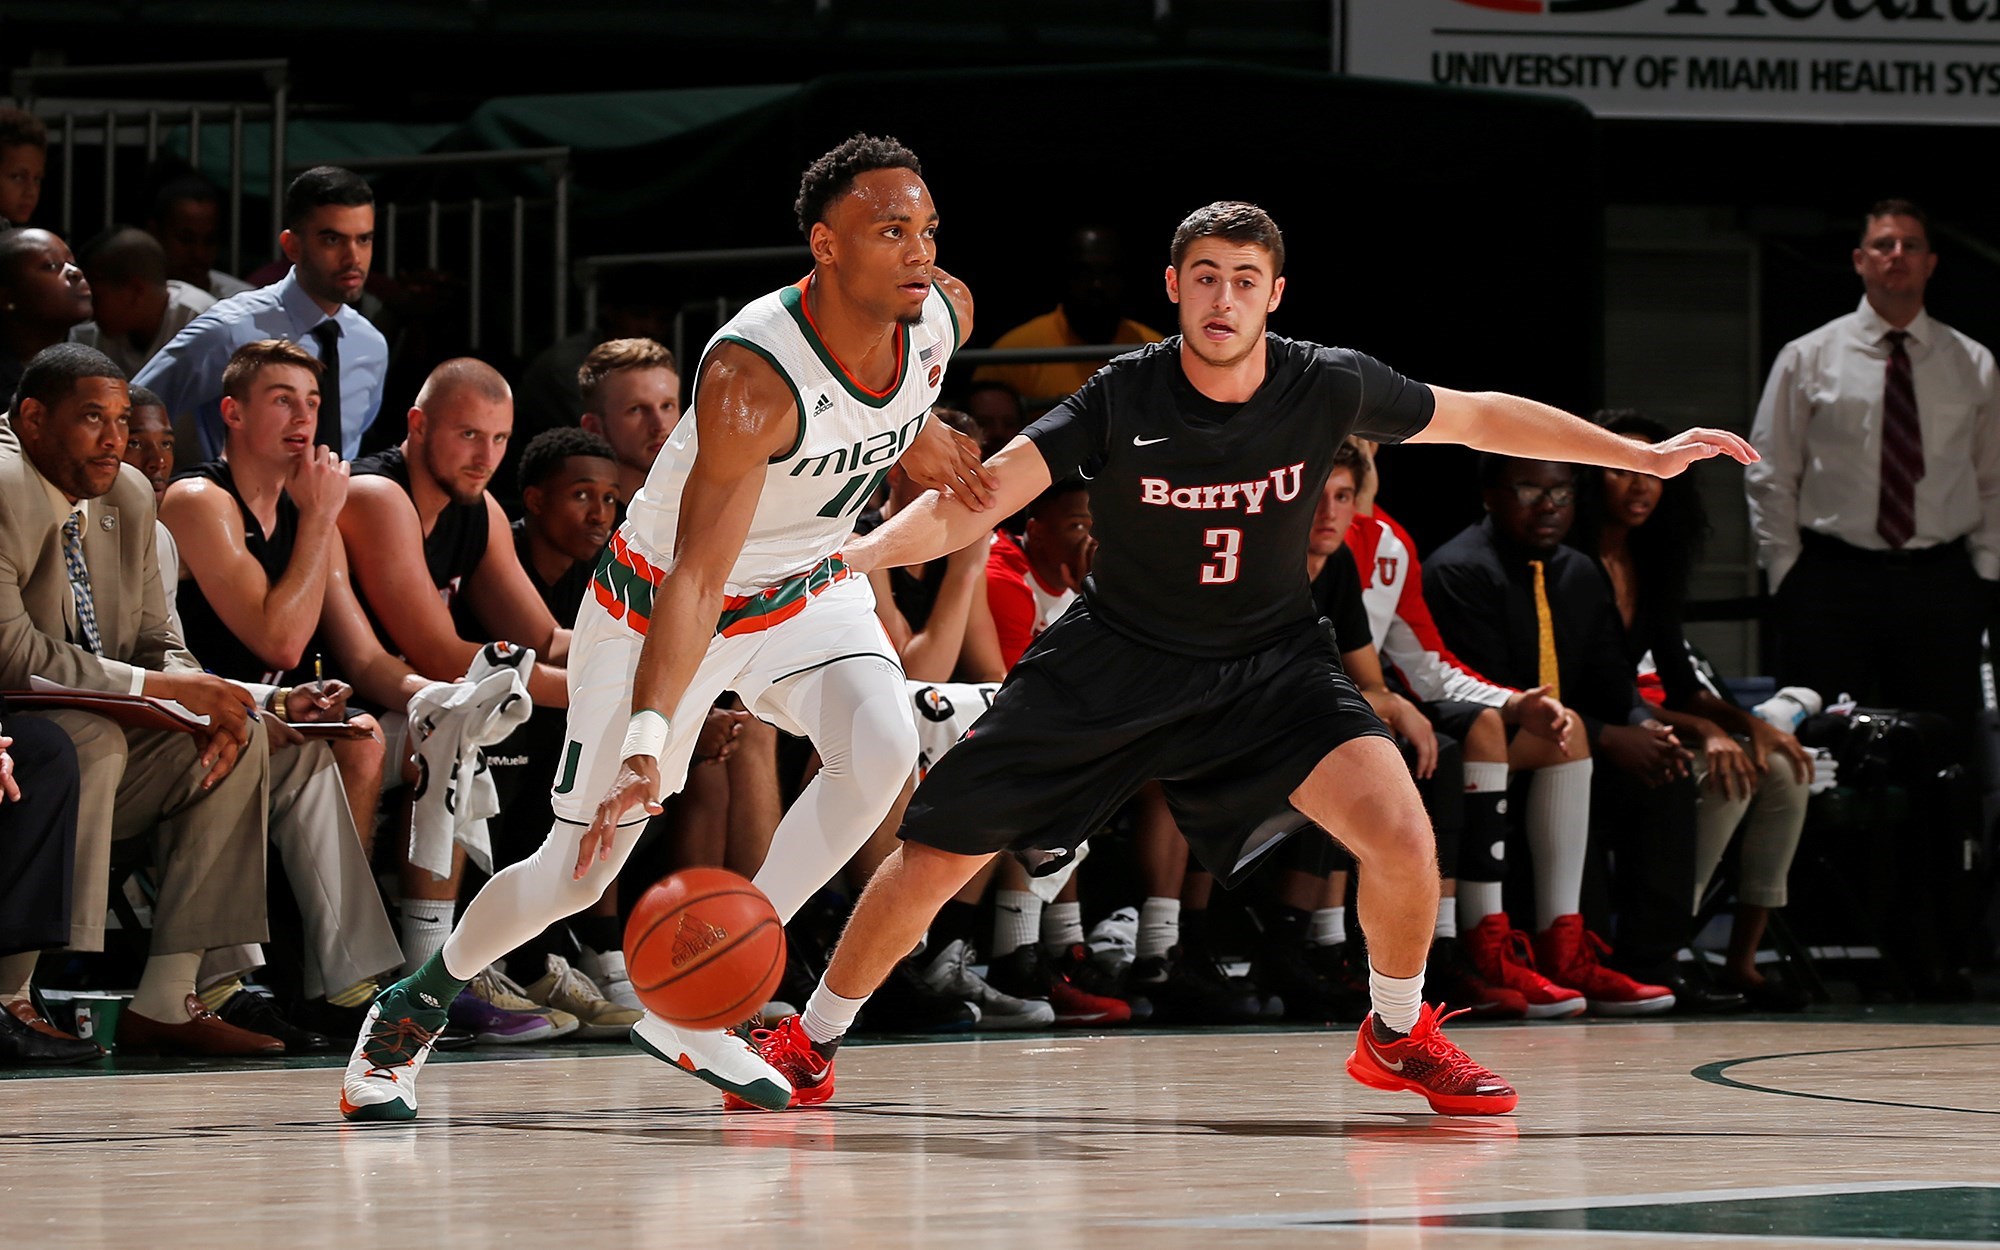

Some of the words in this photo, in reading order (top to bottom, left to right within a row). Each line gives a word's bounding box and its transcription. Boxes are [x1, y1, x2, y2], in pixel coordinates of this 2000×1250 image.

[1432, 52, 1626, 88] UNIVERSITY
[1634, 56, 1679, 90] OF
[1687, 57, 1798, 91] MIAMI
[1810, 59, 1934, 94] HEALTH
[1200, 528, 1243, 585] 3
[1377, 556, 1398, 586] U
